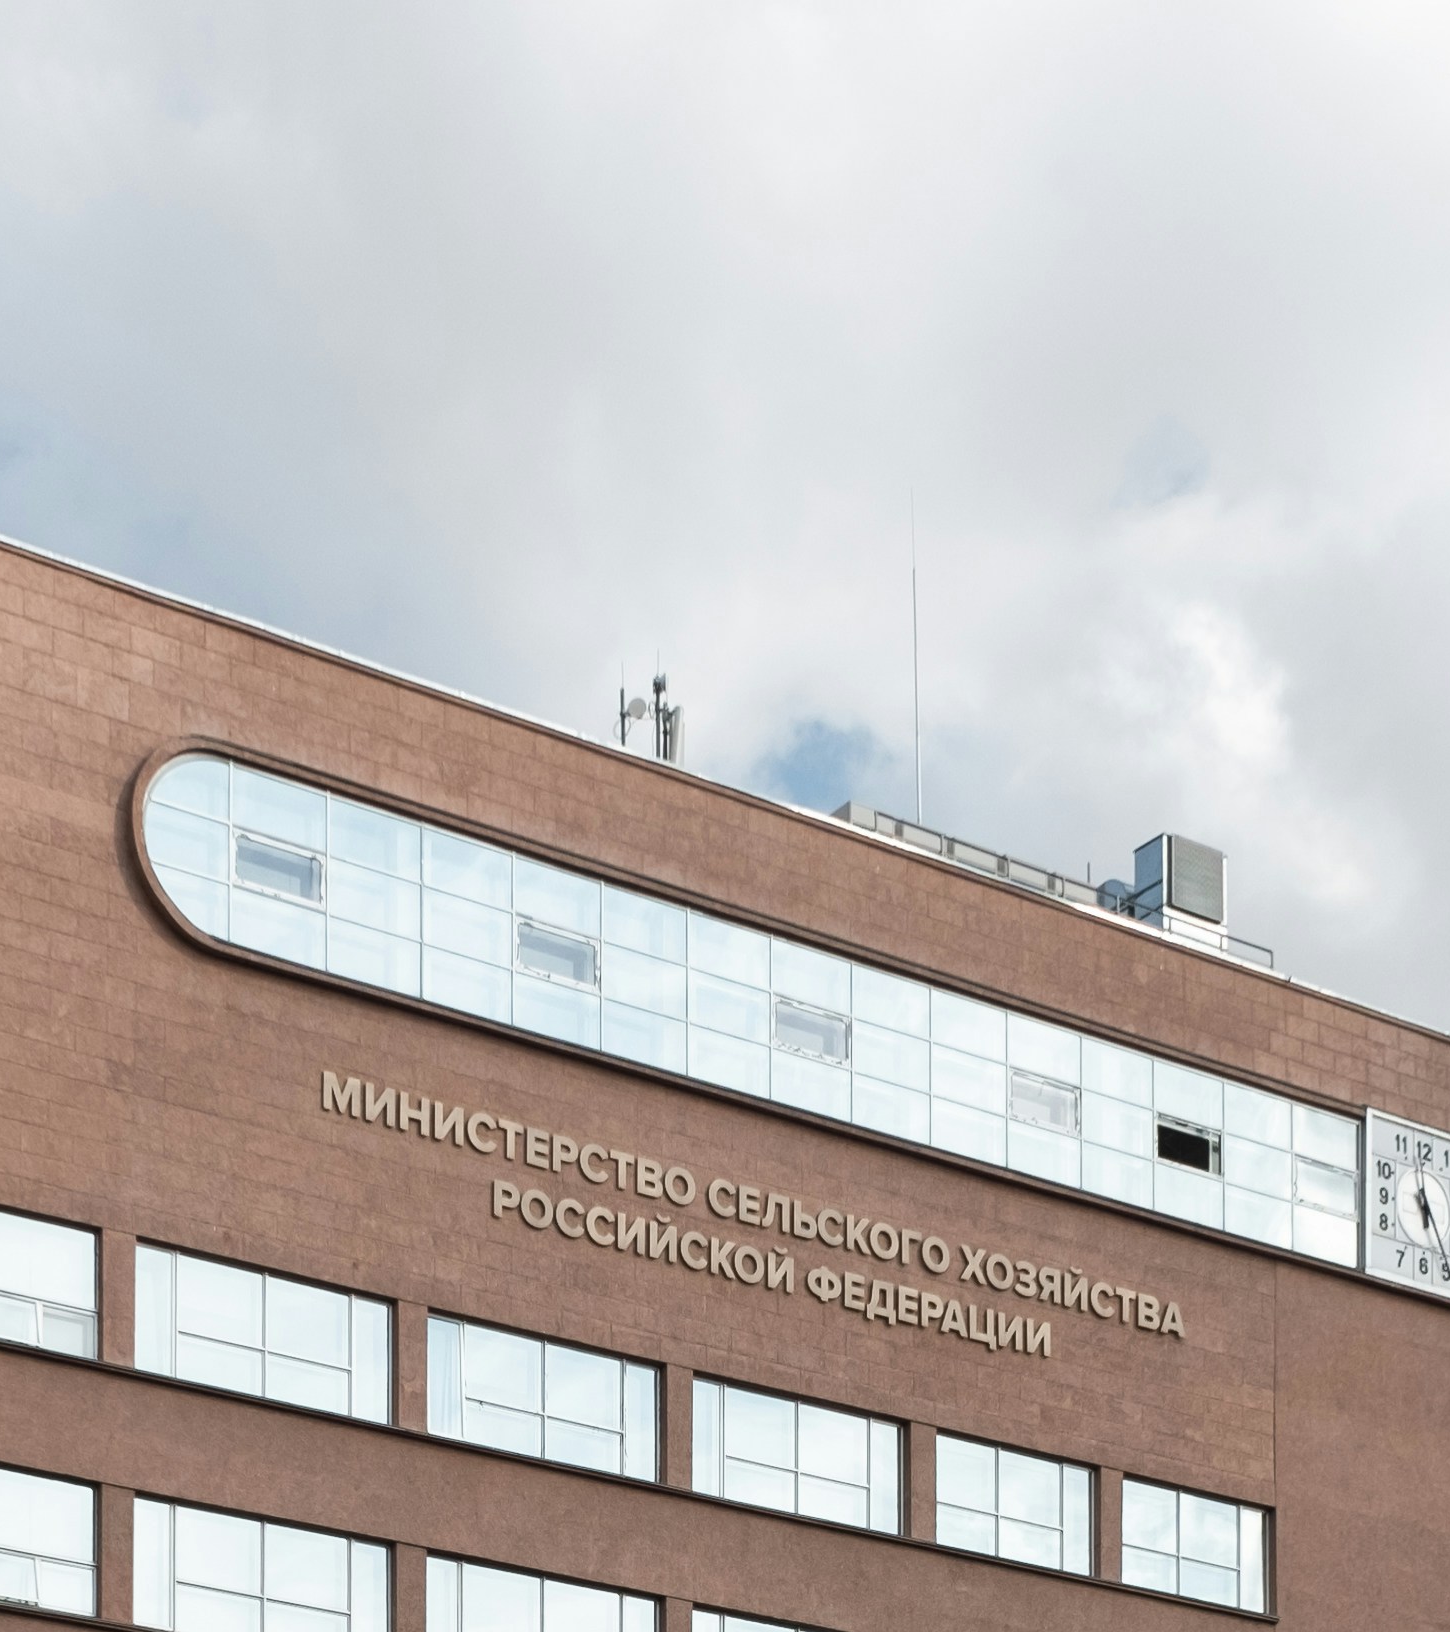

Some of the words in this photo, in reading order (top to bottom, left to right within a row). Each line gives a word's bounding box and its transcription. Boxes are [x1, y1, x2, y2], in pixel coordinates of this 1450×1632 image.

[1395, 1134, 1407, 1155] 11
[1417, 1141, 1432, 1162] 12
[1443, 1150, 1450, 1168] 1
[1377, 1160, 1391, 1179] 10
[321, 1069, 696, 1206] МИНИСТЕРСТВО
[707, 1177, 950, 1275] СЕЛЬСКОГО
[960, 1244, 1186, 1339] ХОЗЯЙСТВА
[1379, 1188, 1389, 1204] 9
[1379, 1213, 1389, 1231] 8
[492, 1178, 796, 1295] РОССИЙСКОЙ
[807, 1266, 1051, 1357] ФЕДЕРАЦИИ
[1396, 1249, 1406, 1268] 7
[1419, 1257, 1428, 1274] 6
